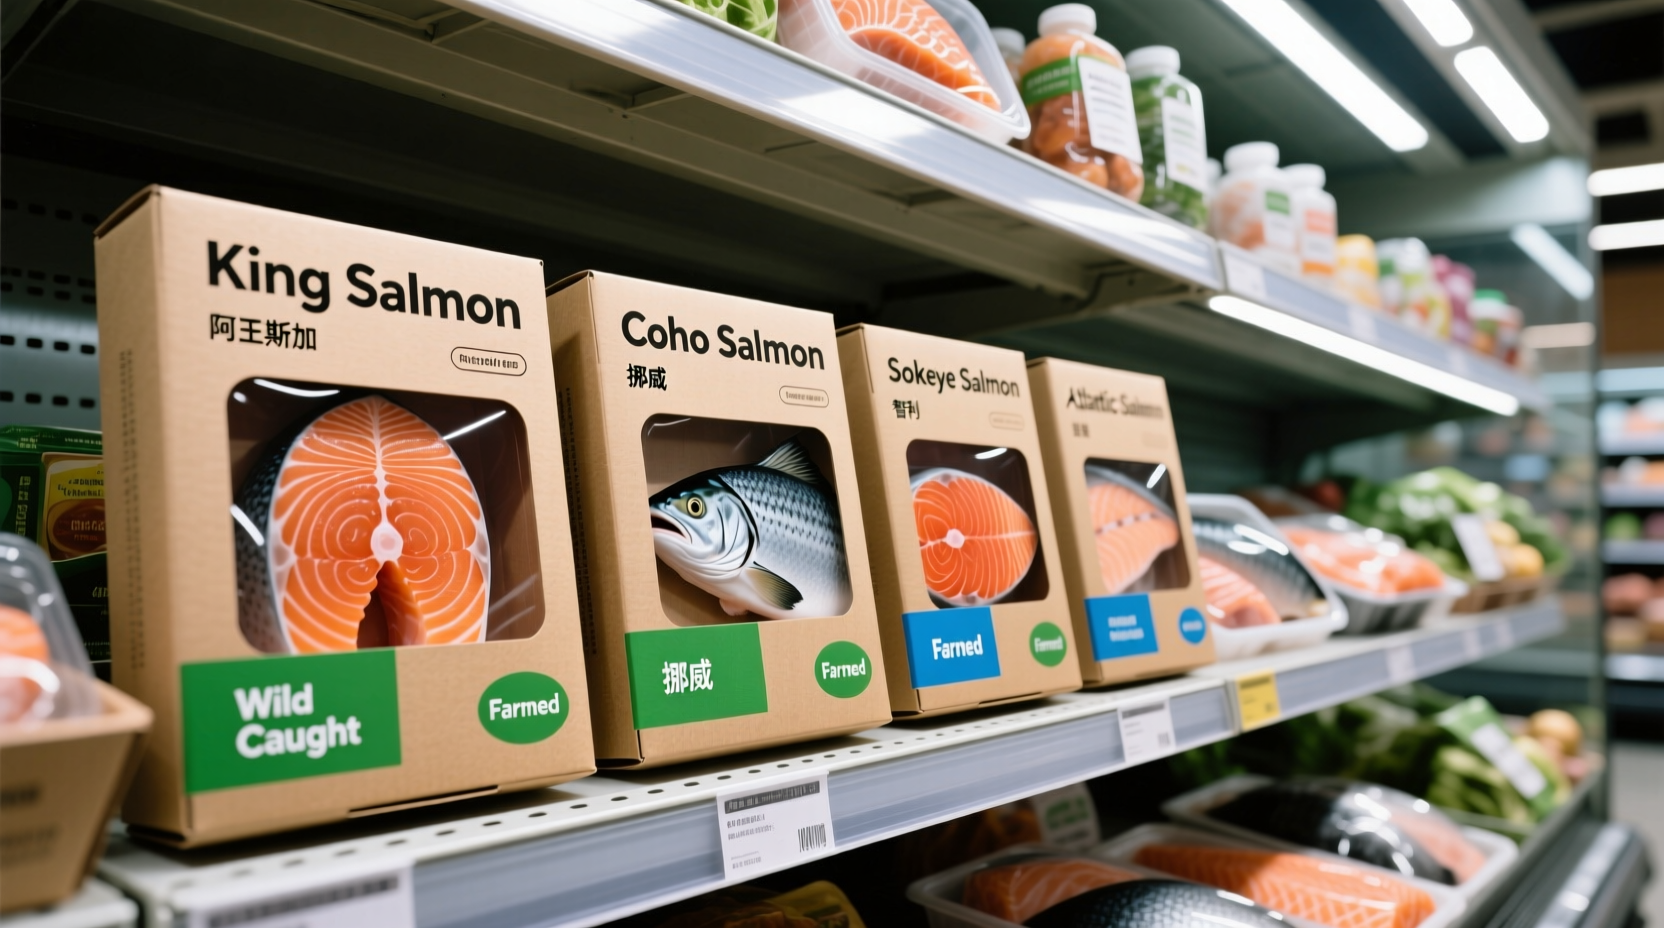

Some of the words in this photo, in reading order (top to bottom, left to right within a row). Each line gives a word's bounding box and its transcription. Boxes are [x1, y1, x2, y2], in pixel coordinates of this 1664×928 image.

[207, 240, 331, 313] King
[346, 262, 522, 330] Salmon
[209, 313, 318, 351] 阿王斯加
[621, 310, 710, 355] Coho
[717, 324, 825, 370] Salmon
[887, 357, 956, 394] Sokeye
[233, 682, 314, 721] Wild
[489, 692, 561, 721] Farmed
[235, 715, 362, 759] Caught
